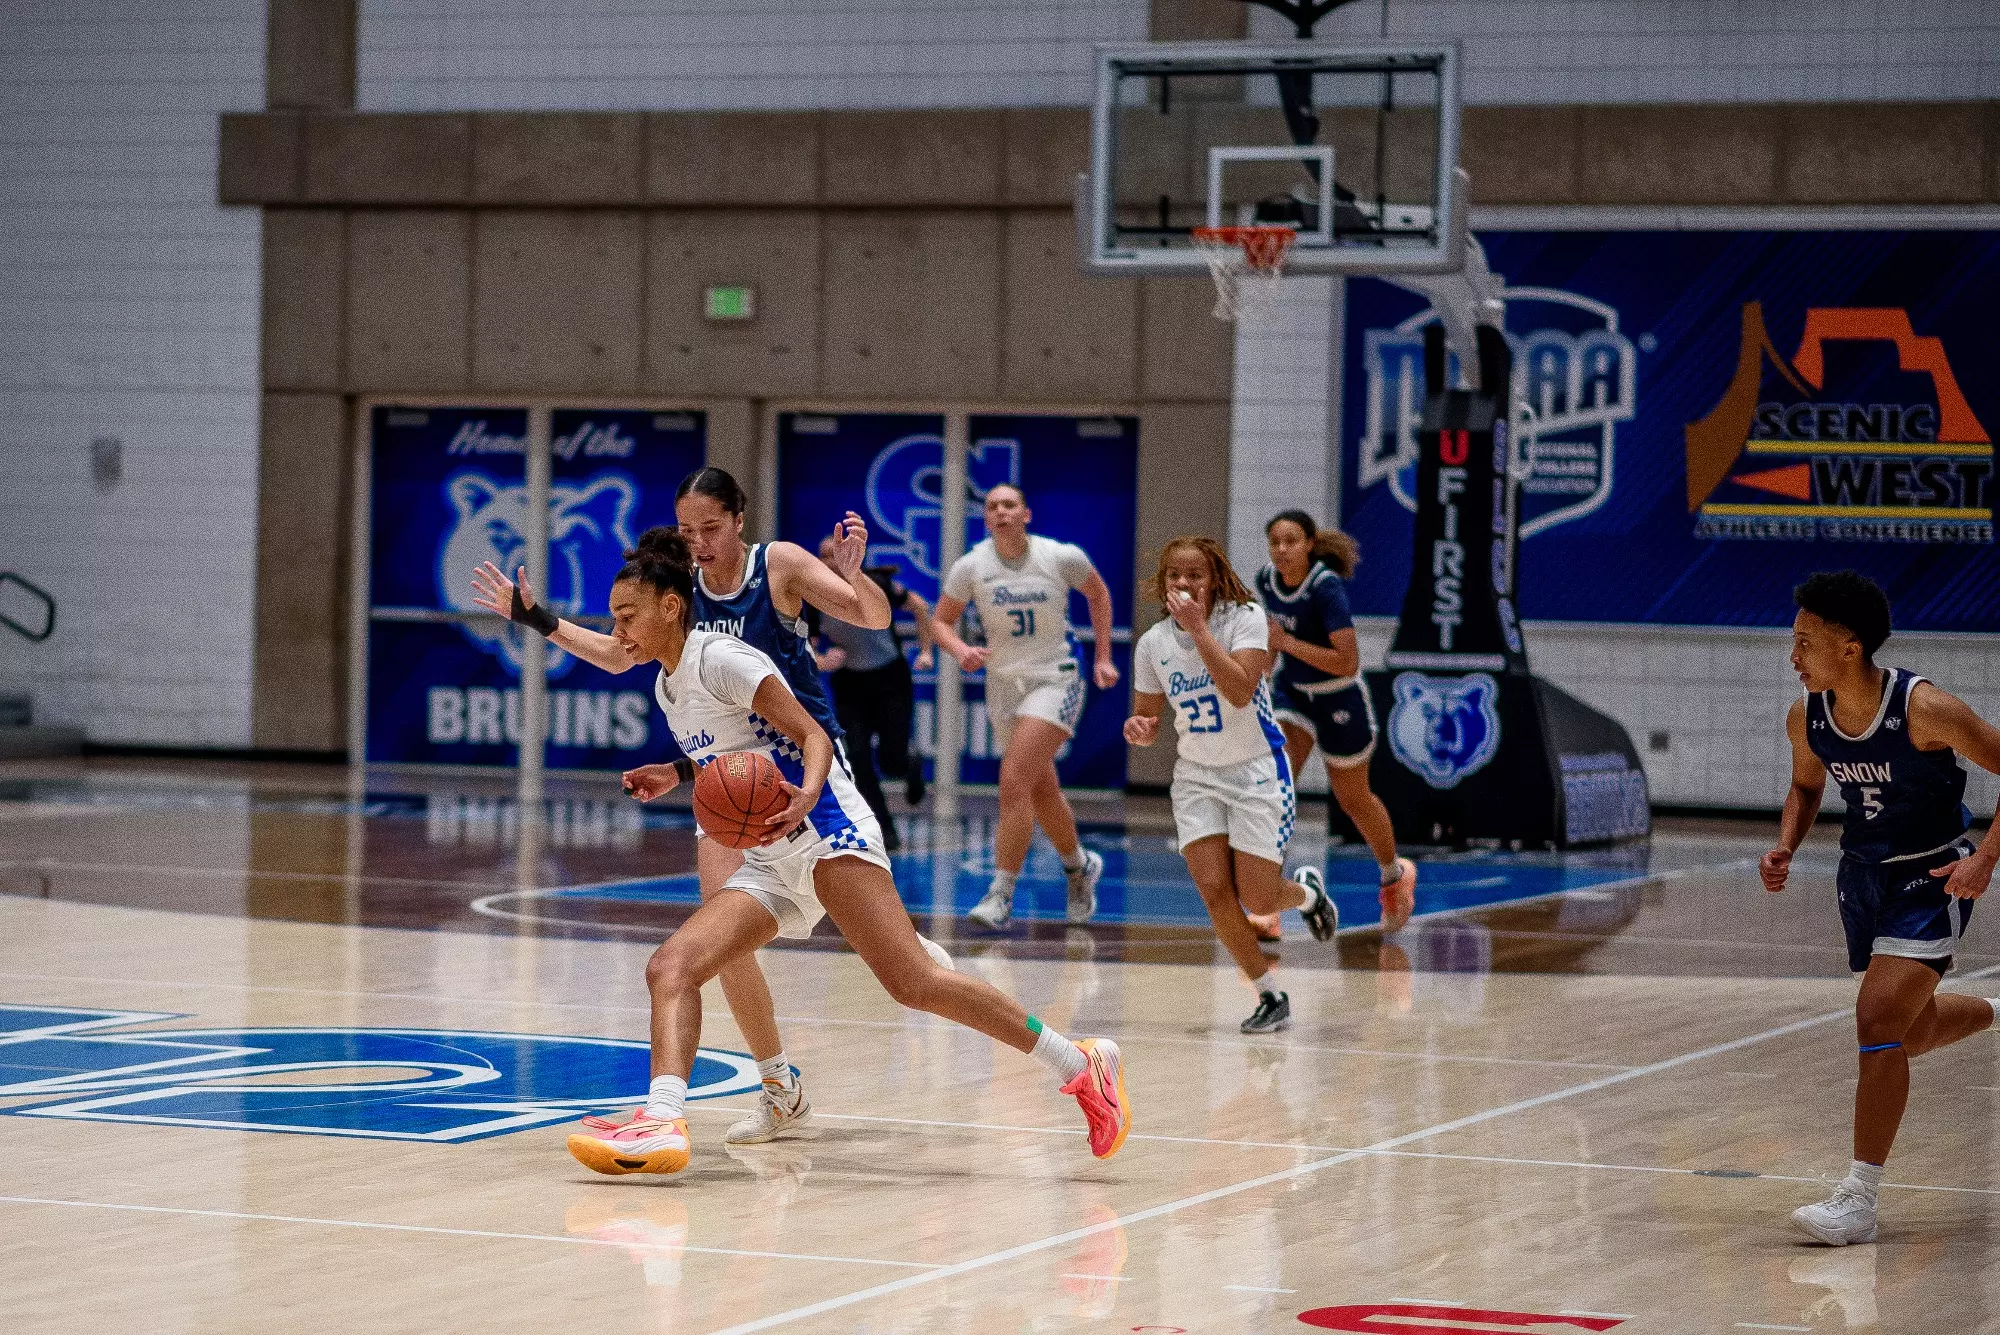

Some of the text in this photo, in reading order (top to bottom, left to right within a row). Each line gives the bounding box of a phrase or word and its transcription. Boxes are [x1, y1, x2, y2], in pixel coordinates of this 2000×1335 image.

[1754, 402, 1936, 442] SCENIC
[1812, 456, 1993, 509] WEST
[1820, 520, 1993, 543] CONFERENCE
[1432, 467, 1468, 650] FIRST
[1007, 609, 1034, 637] 31
[1179, 694, 1223, 733] 23
[1830, 762, 1892, 783] SNOW
[1860, 786, 1885, 820] 5
